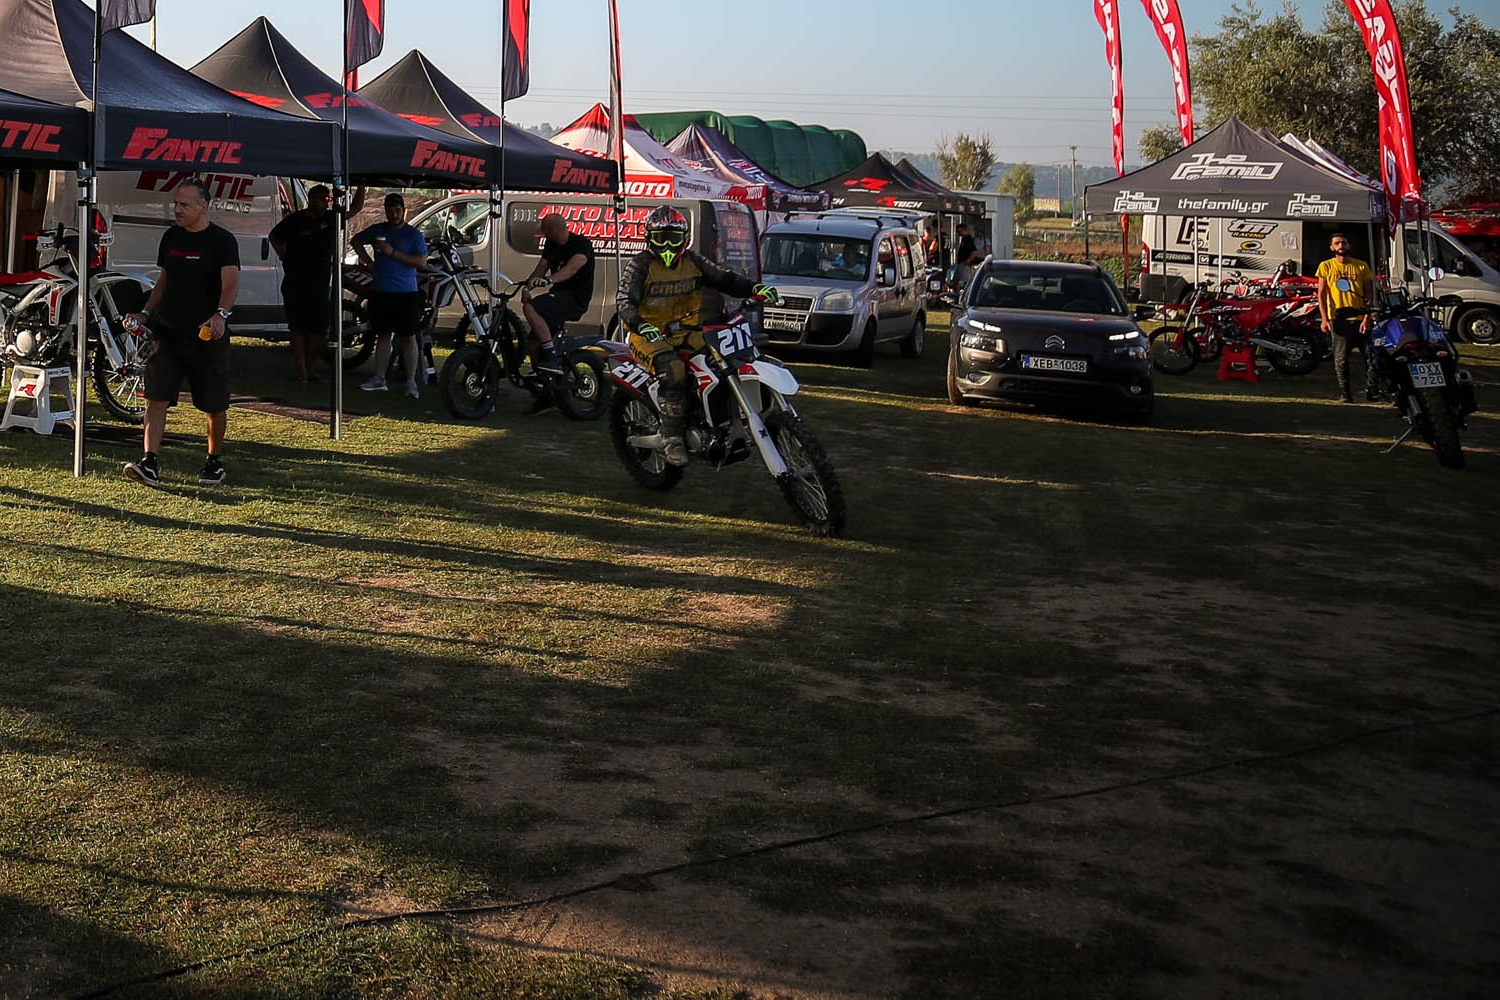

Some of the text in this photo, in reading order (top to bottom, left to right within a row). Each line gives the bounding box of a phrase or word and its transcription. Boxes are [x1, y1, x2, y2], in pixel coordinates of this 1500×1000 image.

[122, 126, 242, 164] FANTIC
[410, 139, 487, 178] FANTIC
[551, 159, 611, 189] FANTIC
[1178, 198, 1269, 213] thefamily.gr
[717, 322, 754, 357] 211
[611, 361, 651, 389] 211
